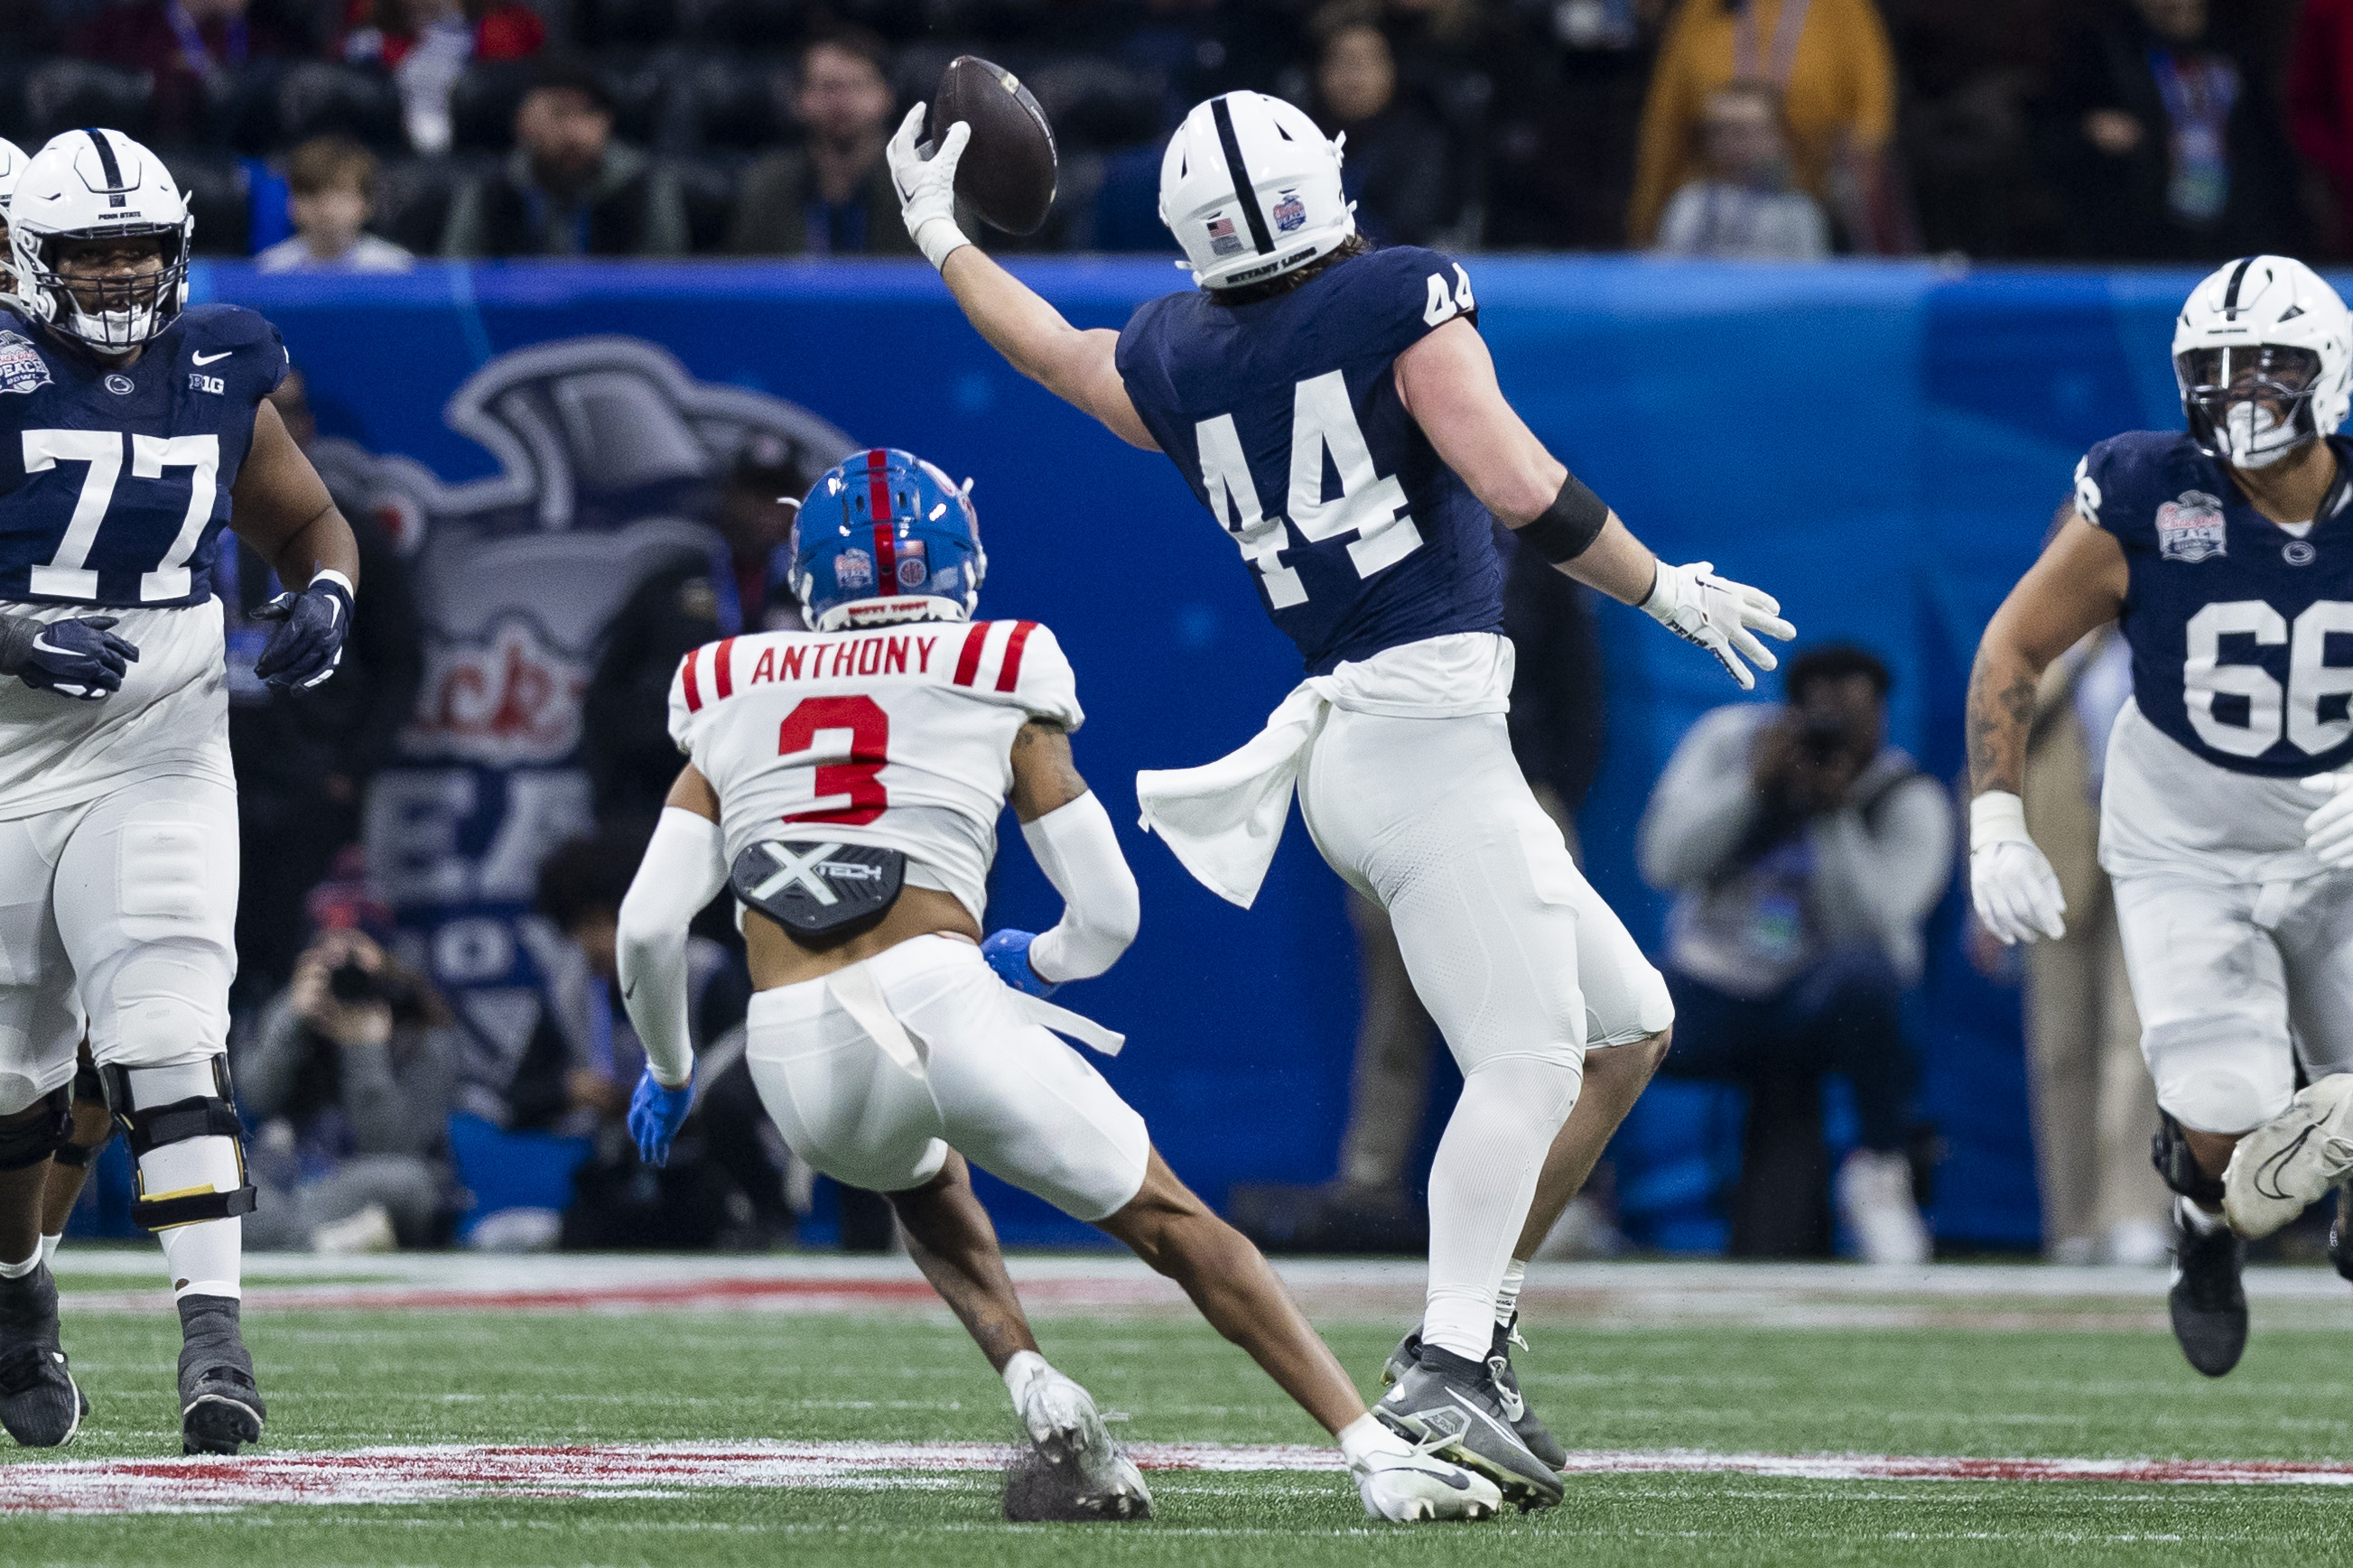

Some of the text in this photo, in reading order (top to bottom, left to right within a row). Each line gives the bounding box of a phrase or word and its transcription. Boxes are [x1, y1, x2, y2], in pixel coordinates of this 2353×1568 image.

[1423, 262, 1474, 327] 44
[22, 429, 219, 602] 77
[1195, 369, 1424, 609] 44
[751, 636, 938, 686] ANTHONY
[2184, 599, 2353, 758] 66
[778, 694, 888, 826] 3
